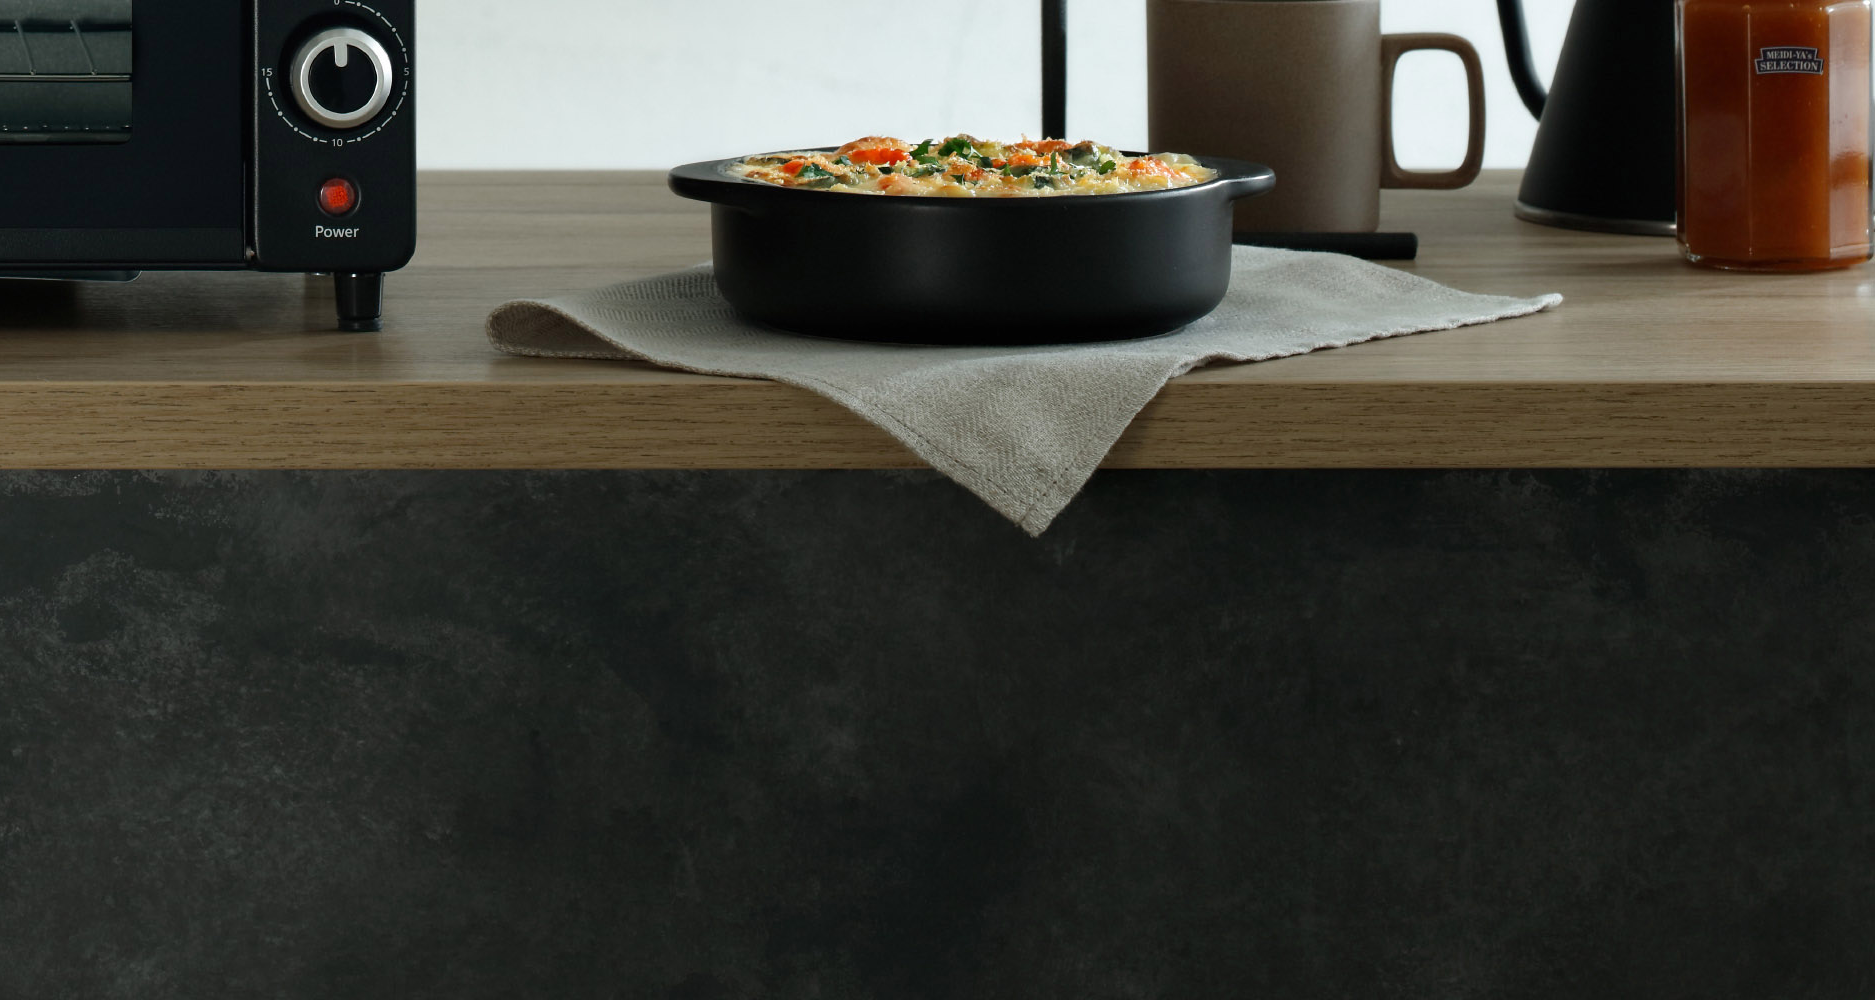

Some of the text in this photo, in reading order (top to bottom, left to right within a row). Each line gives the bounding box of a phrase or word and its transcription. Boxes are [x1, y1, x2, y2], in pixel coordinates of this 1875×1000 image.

[1759, 61, 1819, 71] SELECTION
[261, 67, 273, 77] 15
[403, 67, 410, 76] 5
[331, 138, 344, 147] 10
[315, 224, 360, 239] Power
